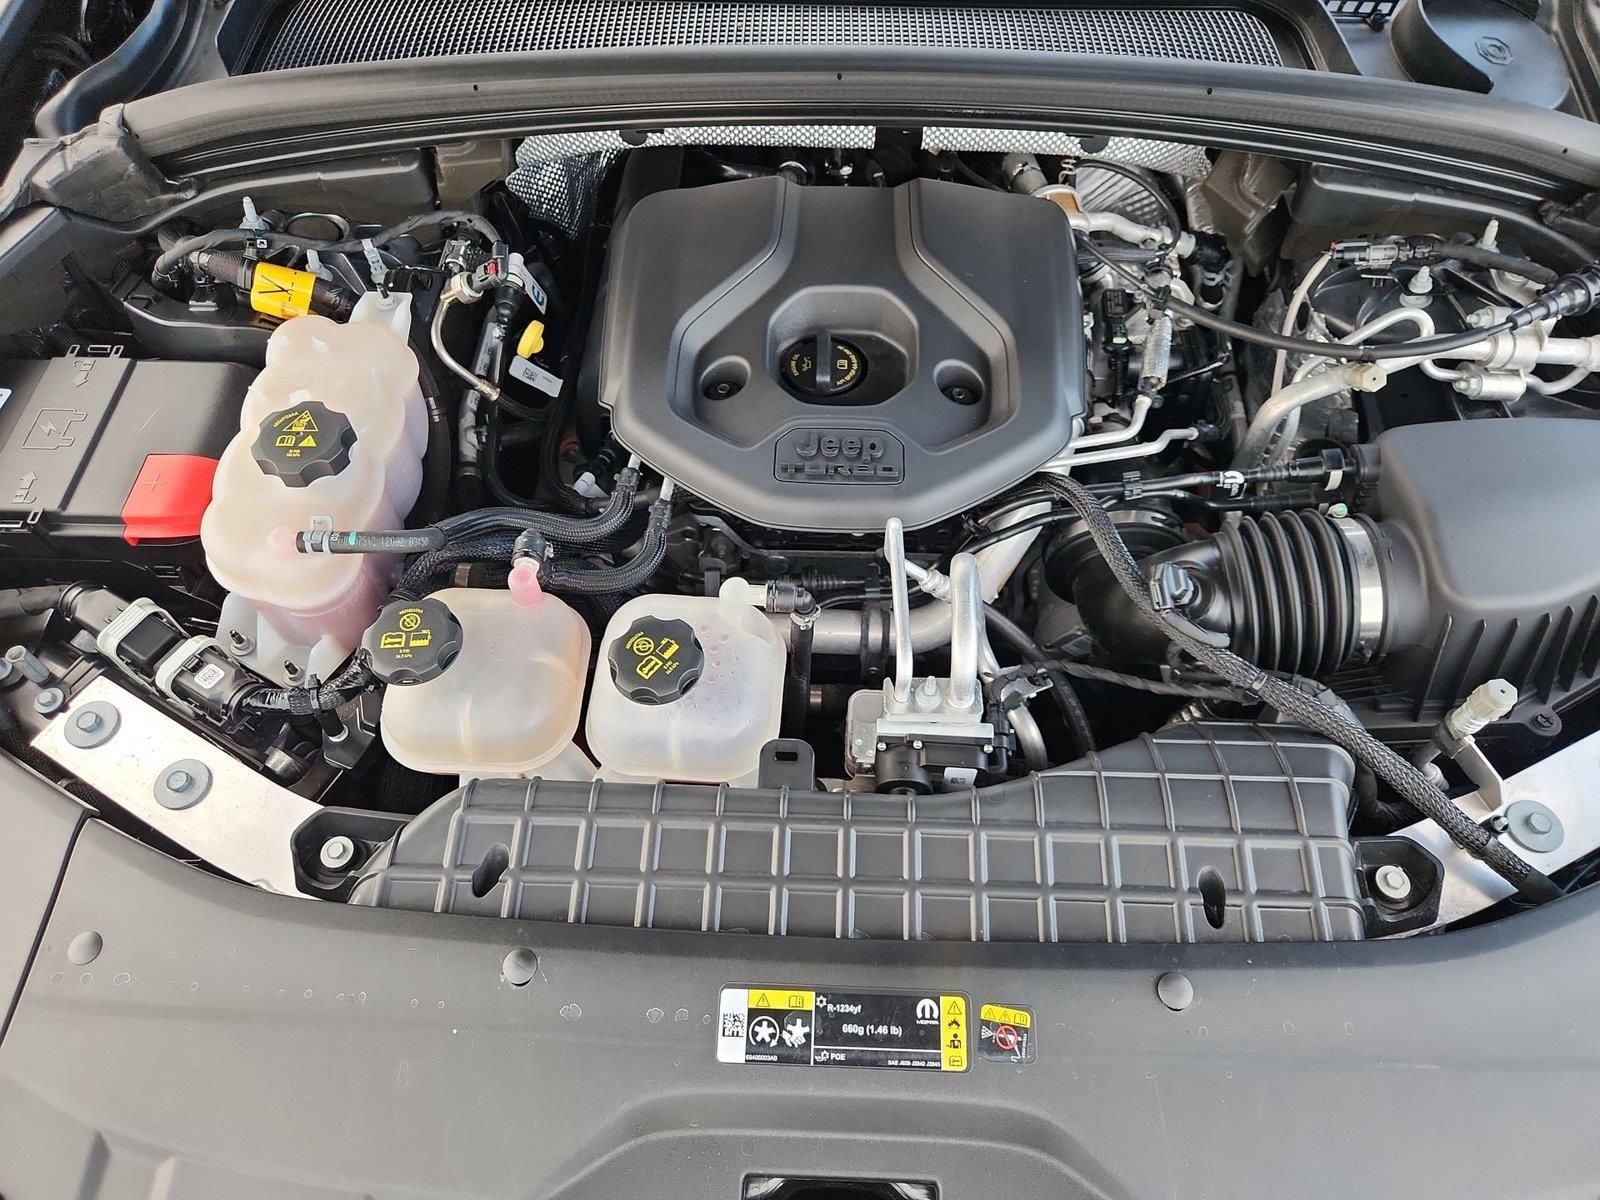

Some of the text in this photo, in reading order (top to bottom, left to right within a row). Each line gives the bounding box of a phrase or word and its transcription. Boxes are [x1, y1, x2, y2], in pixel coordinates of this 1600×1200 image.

[795, 430, 884, 463] Jeep
[827, 1003, 862, 1015] R-1234yf
[842, 1023, 903, 1037] 660g (1.46 lb)
[830, 1053, 846, 1061] POE
